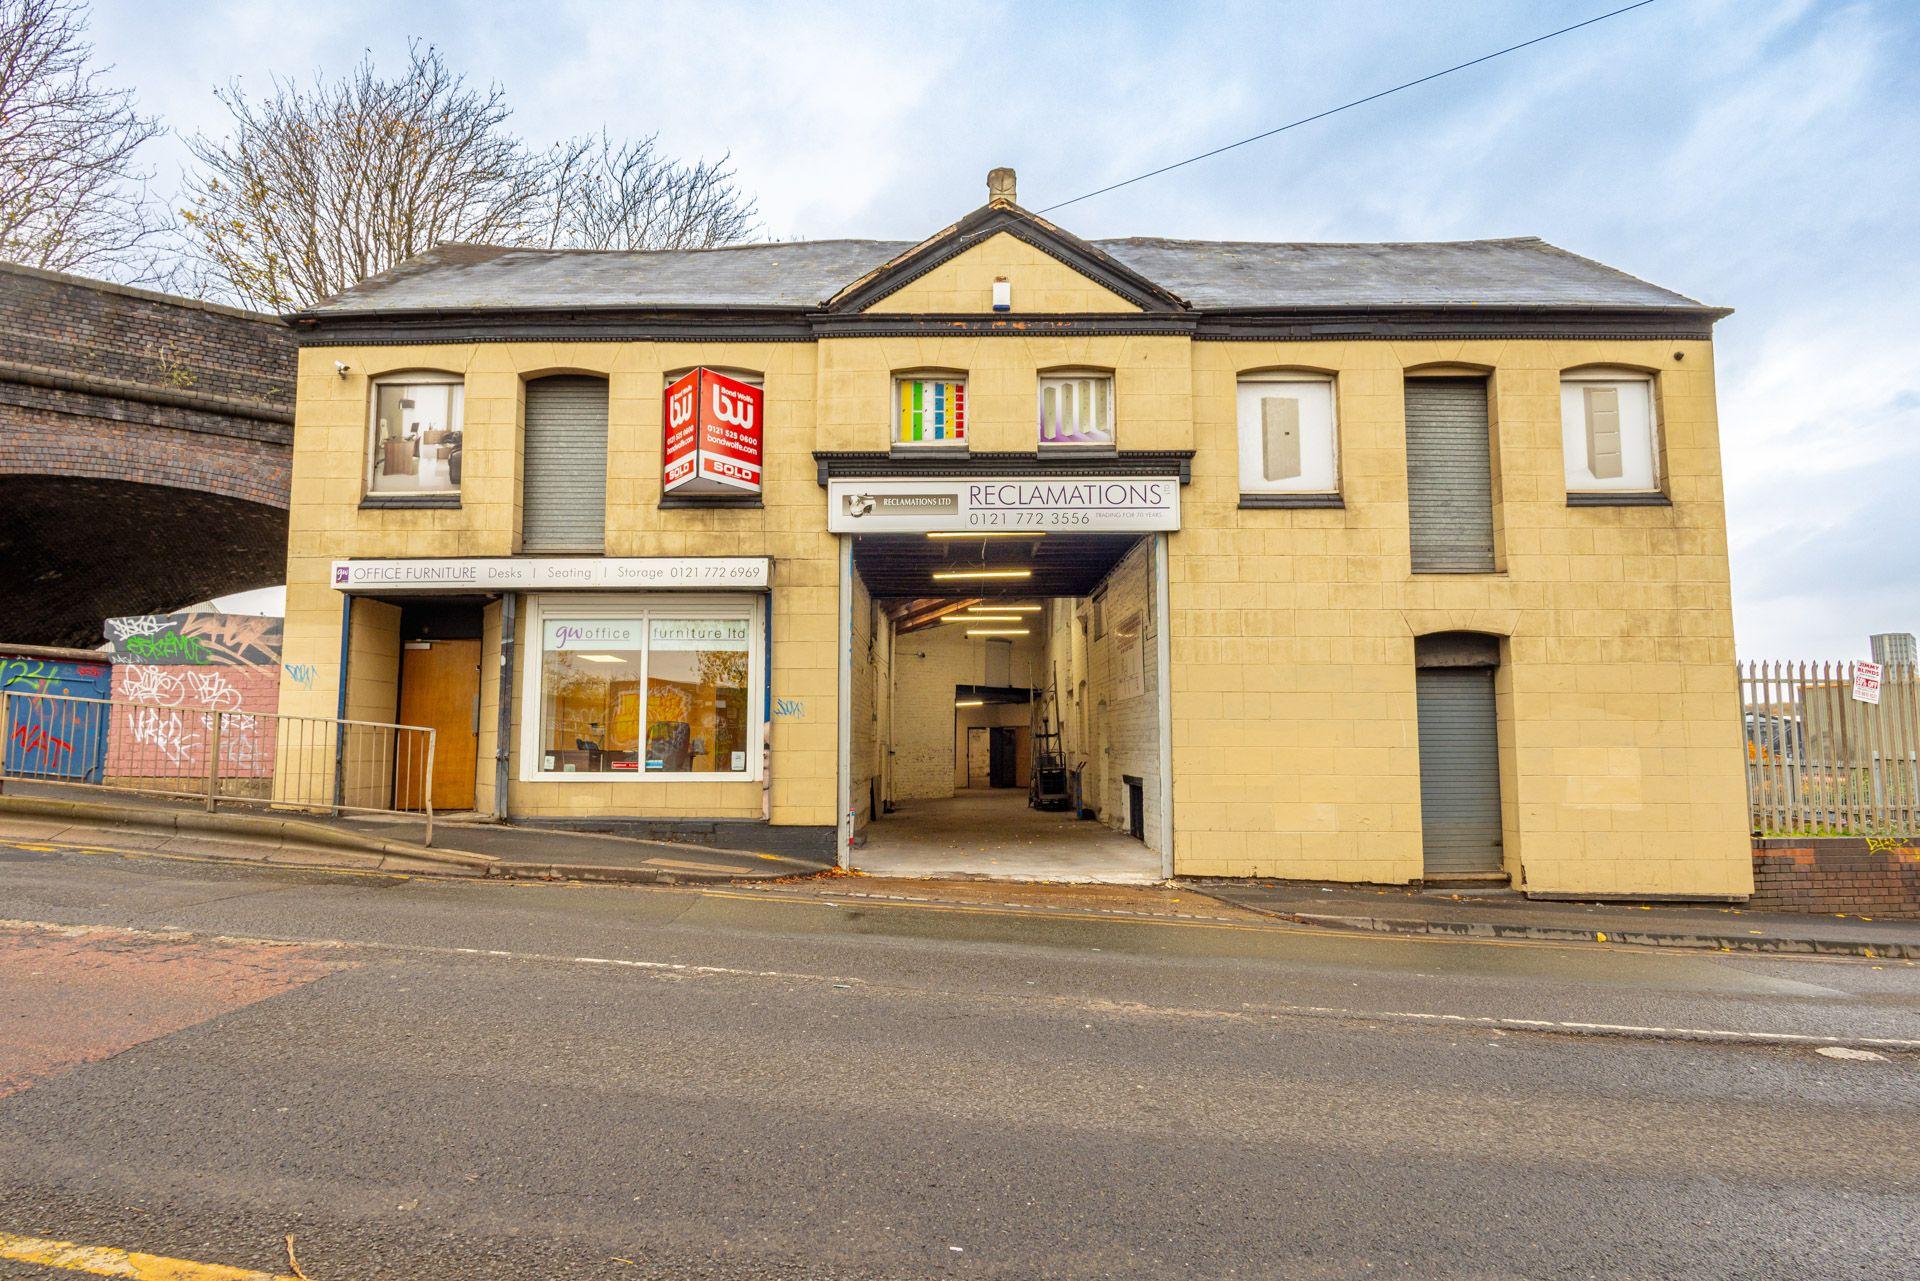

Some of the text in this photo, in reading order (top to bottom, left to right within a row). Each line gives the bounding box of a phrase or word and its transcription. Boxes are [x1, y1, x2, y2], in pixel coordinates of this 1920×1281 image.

[707, 424, 723, 435] 0121
[725, 429, 738, 440] 525
[707, 433, 758, 455] bondwolfe.com
[669, 462, 689, 480] SOLD
[713, 461, 752, 480] SOLD
[970, 484, 1162, 505] RECLAMATIONS
[883, 498, 951, 506] RECLAMATIONS LTD
[970, 512, 1090, 525] 0121 772 3556
[354, 566, 476, 580] OFFICE FURNITURE
[488, 566, 760, 580] Desks Seating Storage 0121 772 6969
[652, 627, 722, 639] furniture
[728, 627, 746, 639] ltd
[1857, 667, 1879, 677] BLINDS
[1859, 662, 1879, 671] JIMMY
